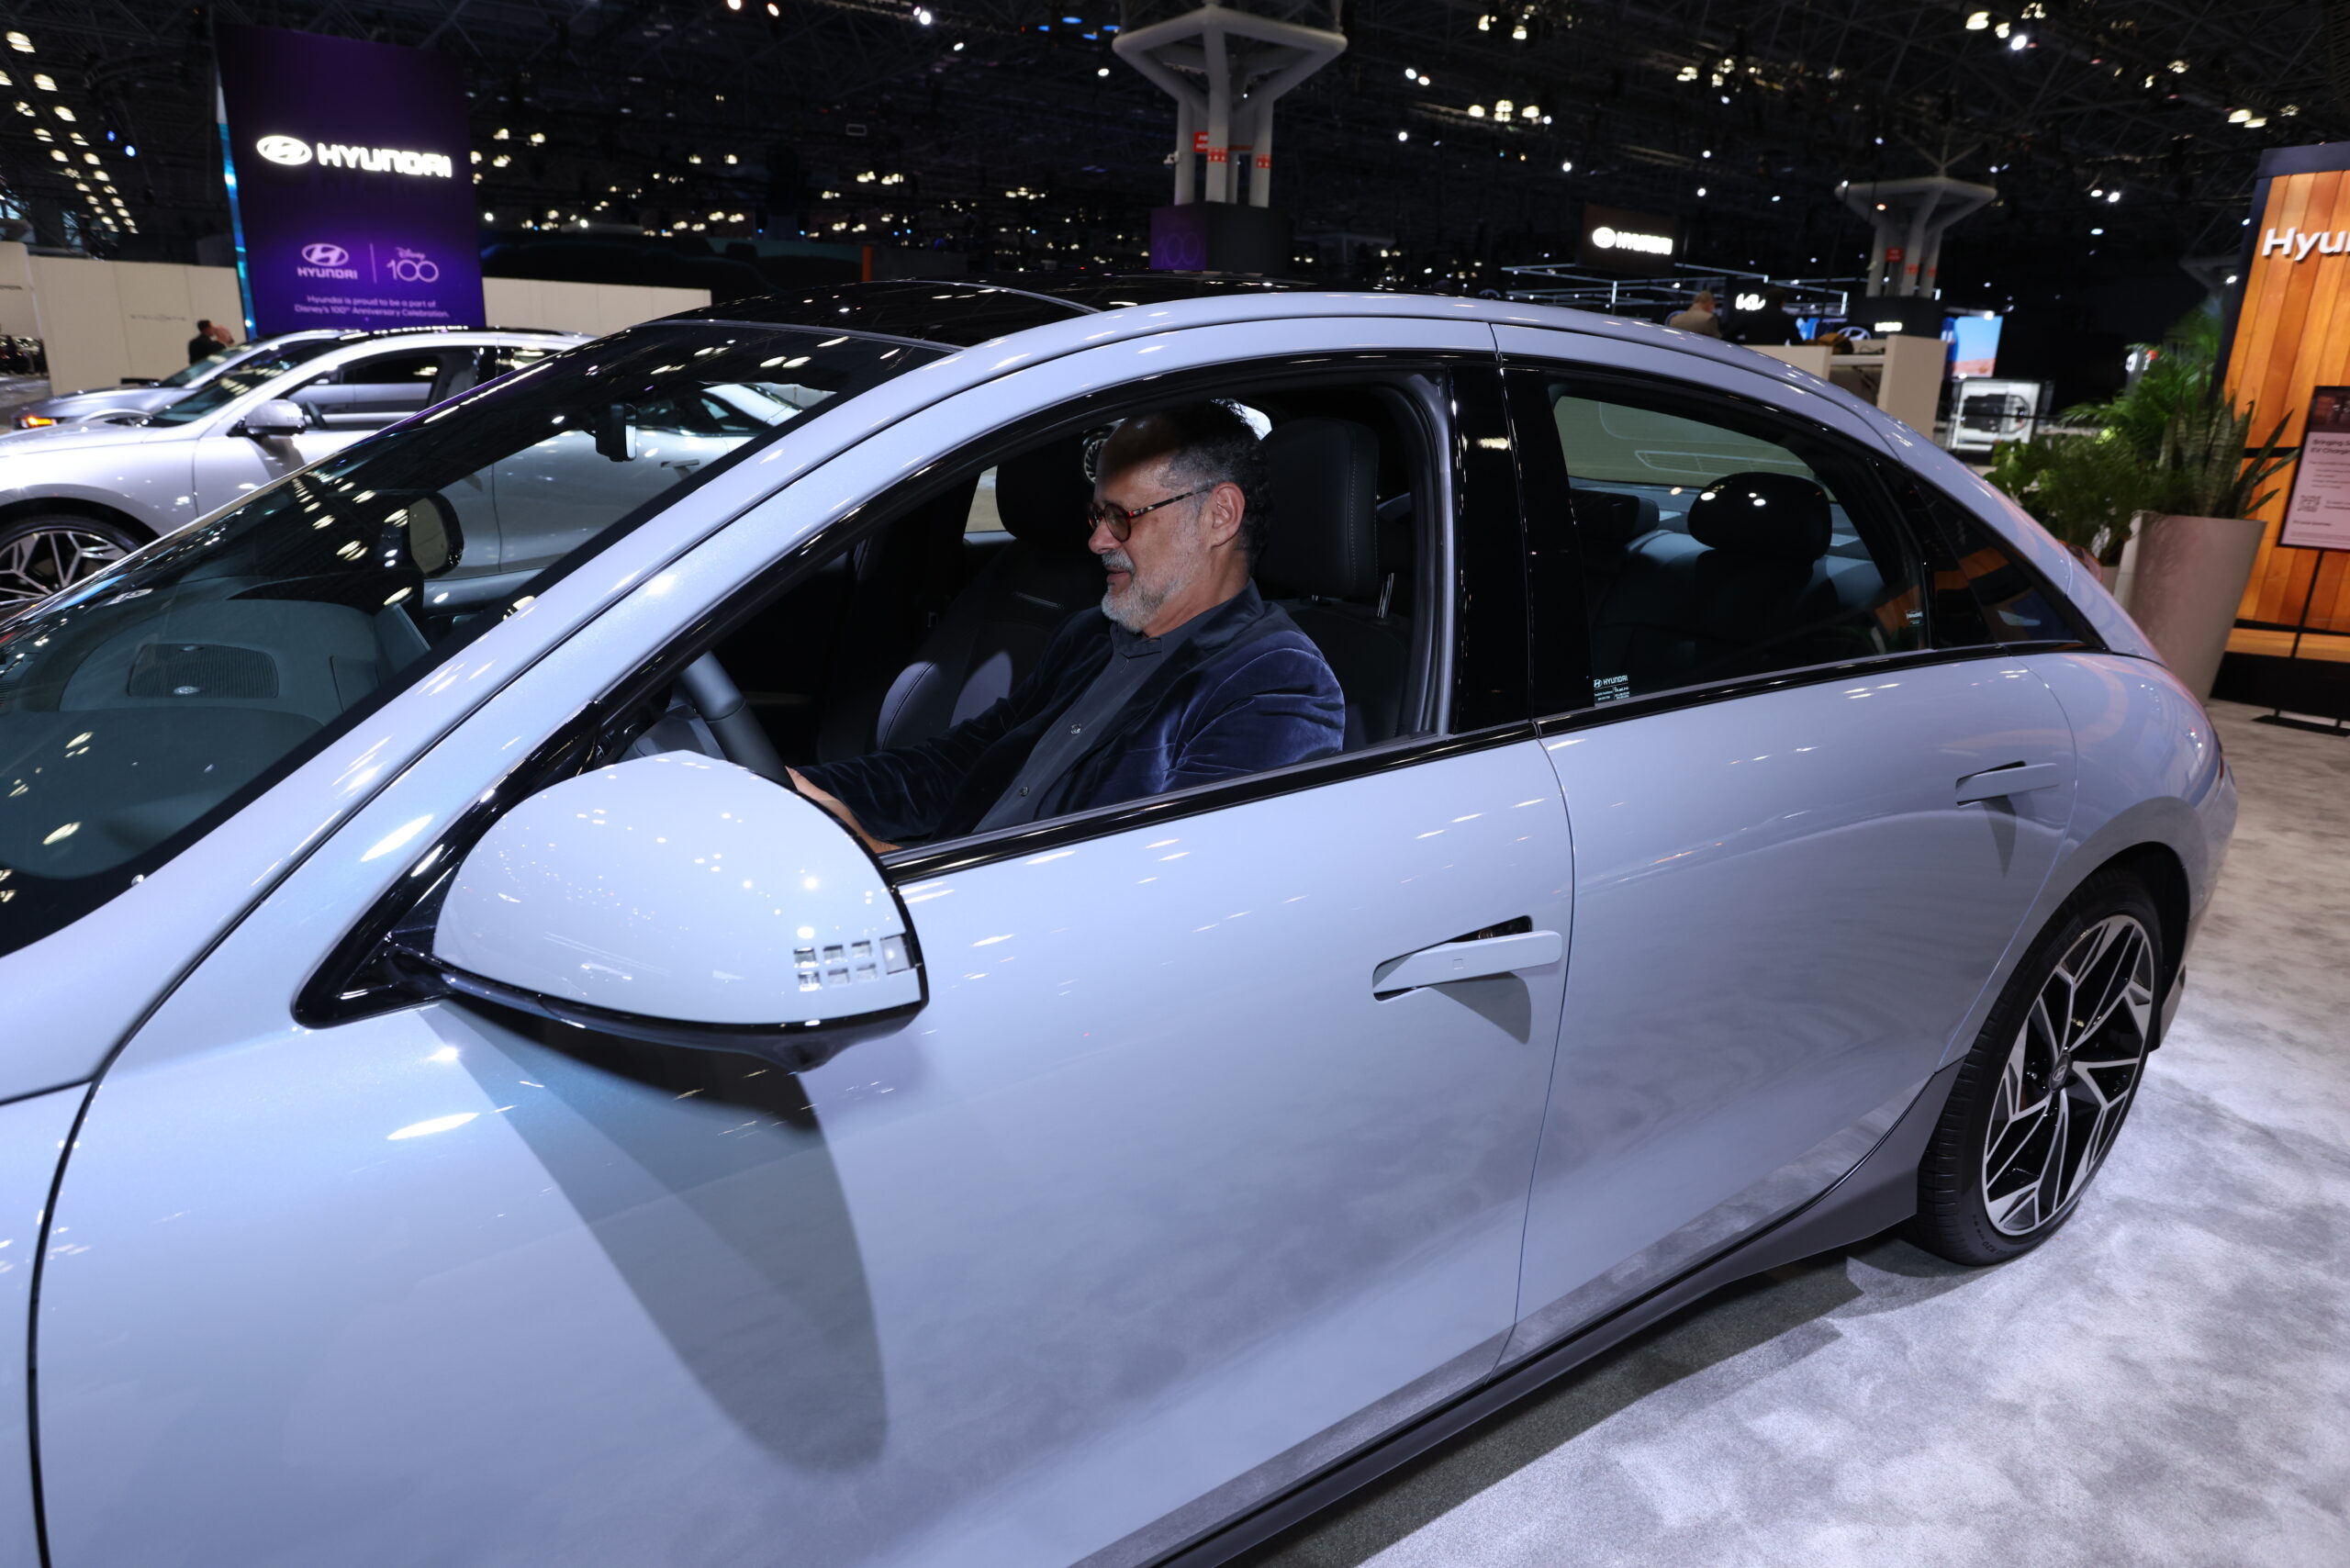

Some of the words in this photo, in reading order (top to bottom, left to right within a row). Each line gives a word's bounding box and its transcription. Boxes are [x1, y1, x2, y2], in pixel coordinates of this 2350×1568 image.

[317, 142, 452, 178] HYUNDAI
[297, 267, 358, 279] HYUNDAI
[386, 258, 440, 283] 100
